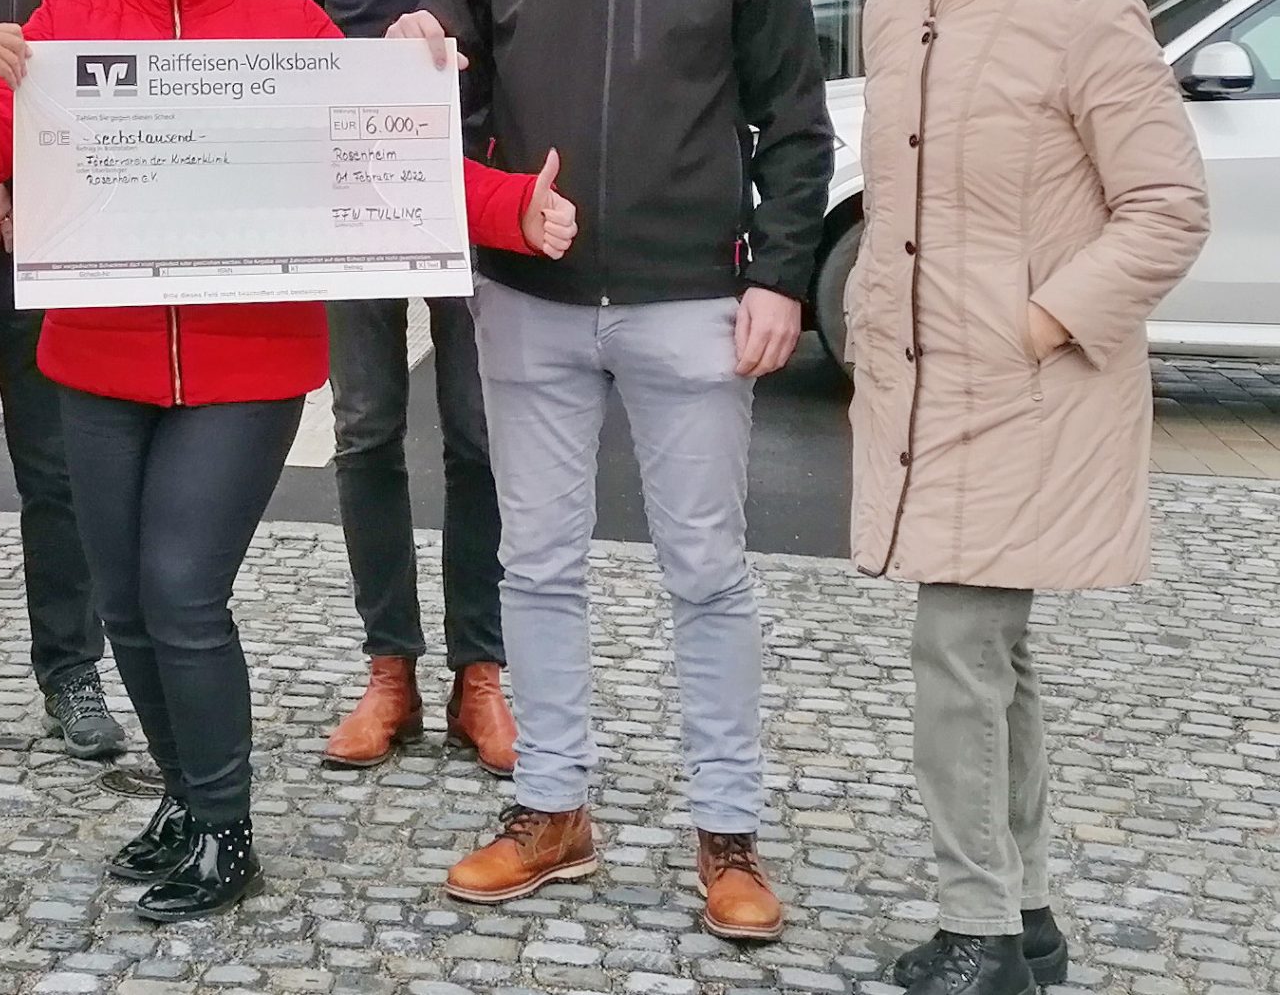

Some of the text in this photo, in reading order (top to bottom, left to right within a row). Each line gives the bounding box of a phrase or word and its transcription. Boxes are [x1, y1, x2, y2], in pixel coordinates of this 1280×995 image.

[148, 52, 341, 72] Raiffeisen-Volksbank
[149, 78, 276, 99] Ebersberg eG
[333, 120, 356, 130] EUR
[38, 130, 71, 146] DE
[333, 147, 397, 161] Rosenheim
[401, 169, 426, 182] 2022
